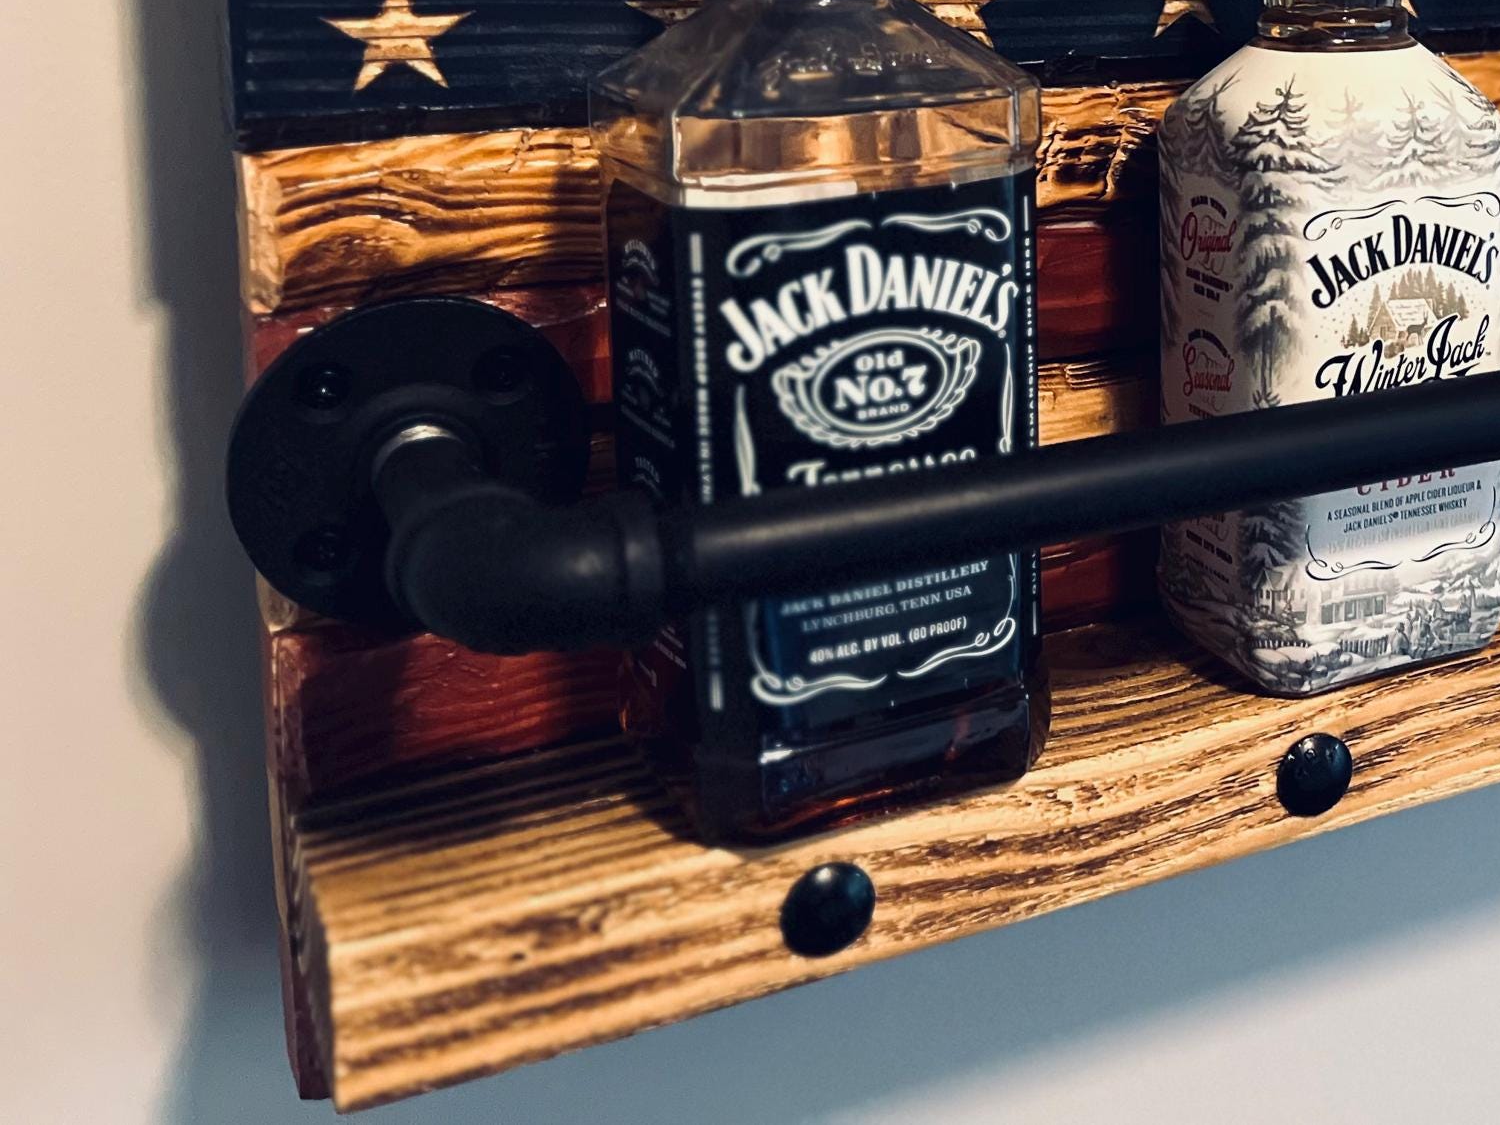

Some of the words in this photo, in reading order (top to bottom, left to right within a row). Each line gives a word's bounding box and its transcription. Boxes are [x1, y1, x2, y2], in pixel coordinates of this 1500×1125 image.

[1305, 231, 1393, 309] JACK
[1391, 214, 1500, 286] DANIEL'S
[719, 267, 847, 373] JACK
[844, 243, 1019, 332] DANIEL'S
[854, 349, 905, 373] Old
[1314, 339, 1429, 398] Winter
[1423, 314, 1491, 382] Jack
[834, 364, 928, 409] No.7
[856, 403, 911, 421] BRAND
[1326, 511, 1333, 522] A
[1333, 505, 1370, 521] SEASONAL
[1371, 498, 1394, 512] BLEND
[1395, 495, 1404, 507] OF
[1404, 491, 1426, 506] APPLE
[1426, 486, 1447, 500] CIDER
[1447, 481, 1474, 497] LIQUEUR
[1473, 479, 1482, 491] &
[1343, 519, 1363, 534] JACK
[1400, 503, 1438, 521] TENNESSEE
[1438, 497, 1468, 512] WHISKEY
[780, 595, 825, 617] JACK
[829, 583, 894, 607] DANIEL
[896, 560, 990, 593] DISTILLERY
[944, 584, 973, 602] USA
[809, 646, 835, 665] 40%
[836, 641, 862, 660] ALC.
[863, 636, 879, 653] BY
[880, 632, 906, 650] VOL.
[908, 626, 927, 644] (80
[929, 615, 968, 638] PROOF)
